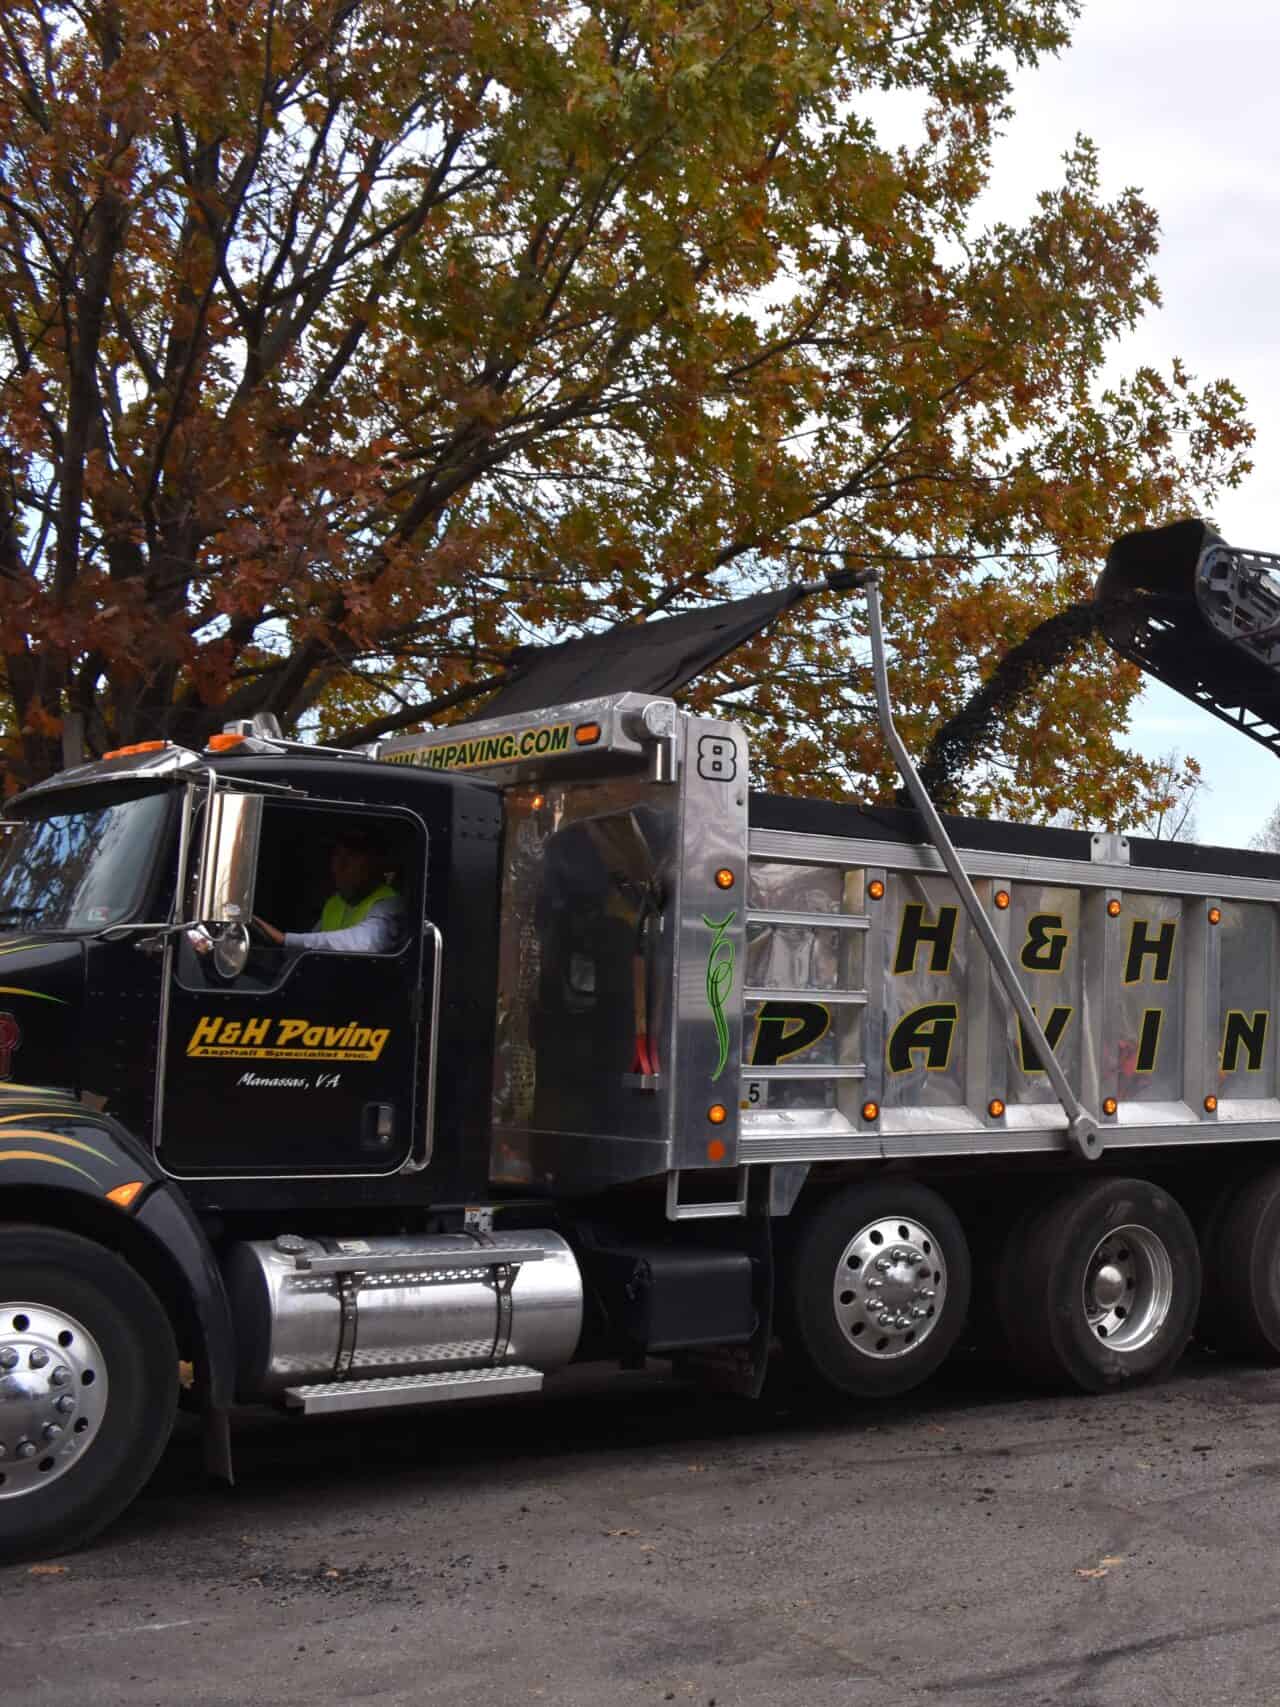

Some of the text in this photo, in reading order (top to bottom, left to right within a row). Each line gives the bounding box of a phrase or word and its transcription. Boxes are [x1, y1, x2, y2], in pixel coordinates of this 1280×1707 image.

[385, 725, 570, 769] WWHHPAVING.COM
[697, 734, 737, 782] 8
[188, 1016, 391, 1058] H&H Paving
[235, 1072, 341, 1090] Manassas, VA
[749, 1082, 760, 1103] 5
